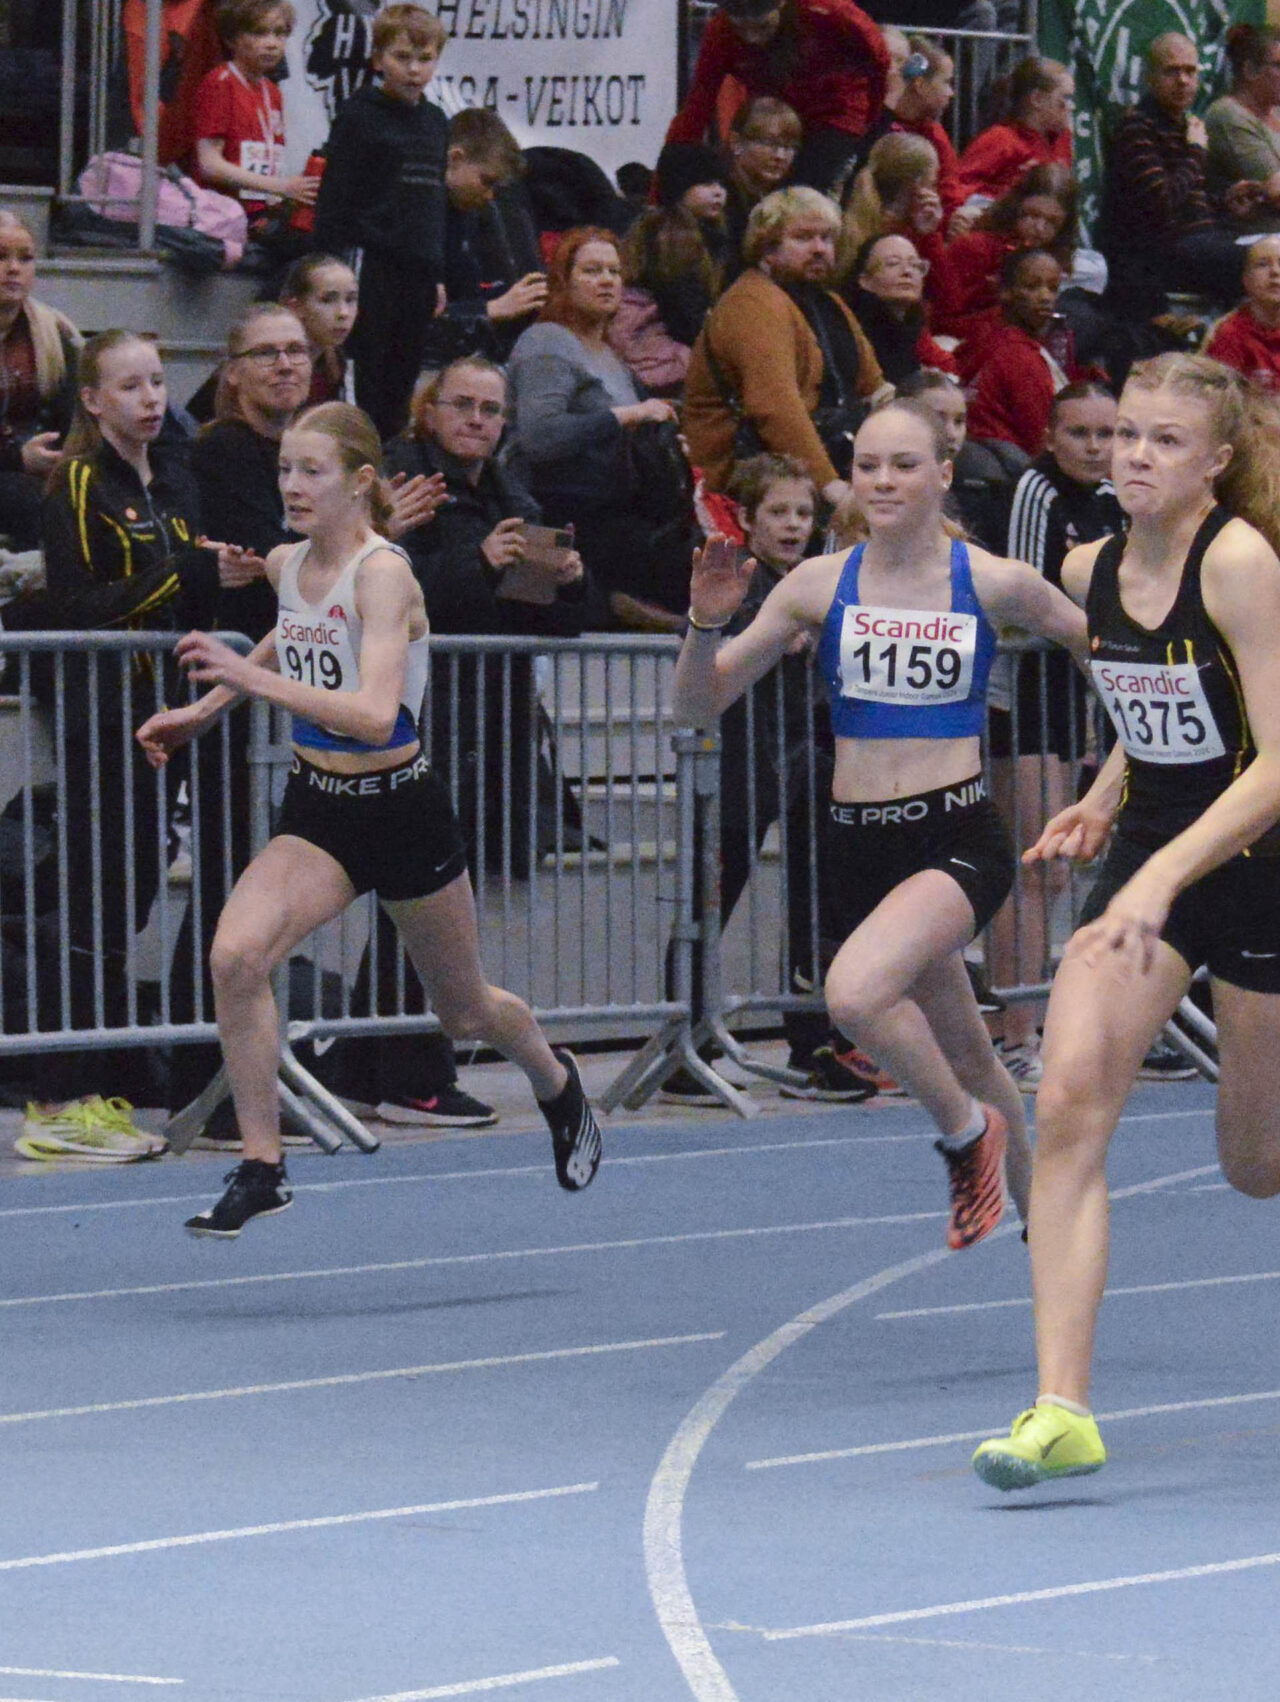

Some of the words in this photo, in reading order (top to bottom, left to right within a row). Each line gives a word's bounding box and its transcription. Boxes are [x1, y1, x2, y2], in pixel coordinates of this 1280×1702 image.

[281, 618, 340, 646] Scandic
[854, 612, 963, 643] Scandic
[286, 645, 342, 691] 919
[853, 641, 961, 690] 1159
[1101, 668, 1190, 695] Scandic
[1113, 697, 1206, 746] 1375
[309, 772, 382, 797] NIKE
[861, 800, 929, 826] PRO
